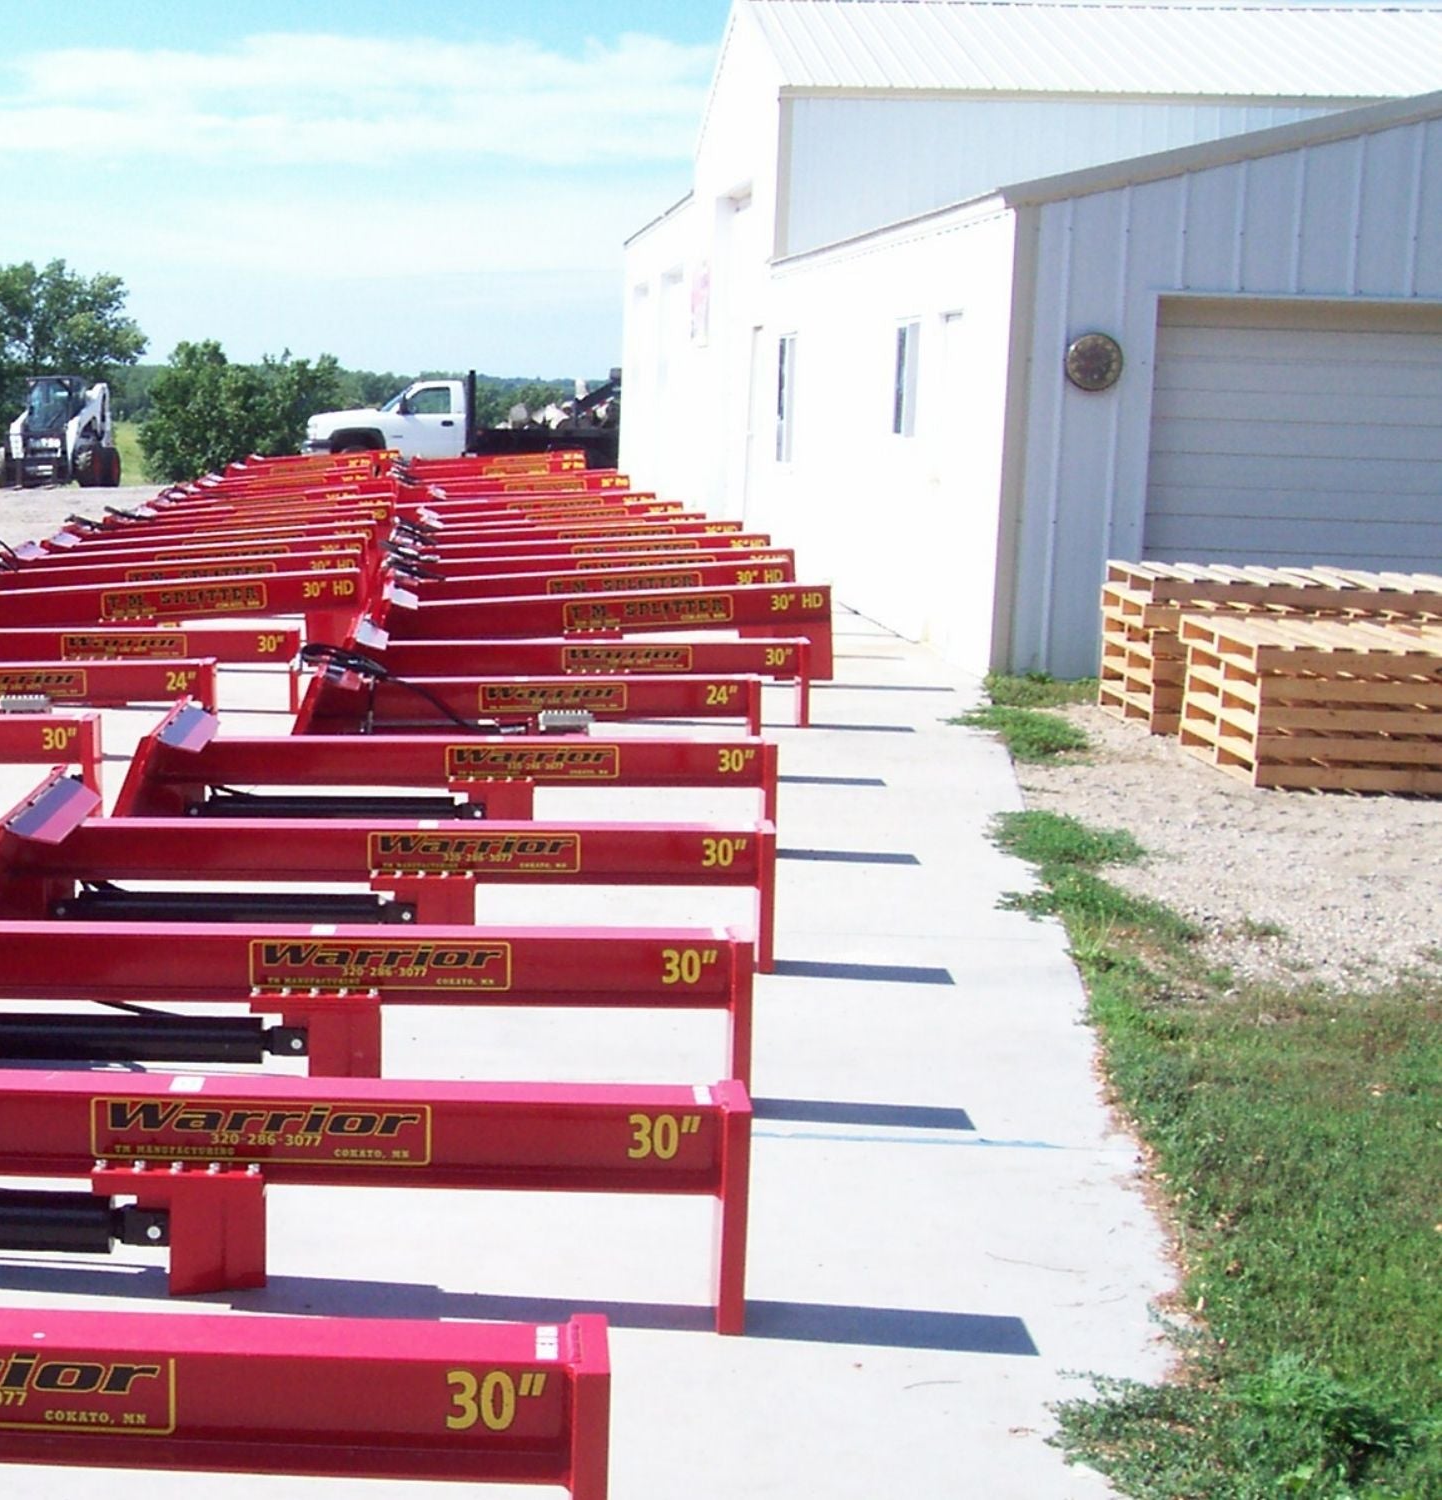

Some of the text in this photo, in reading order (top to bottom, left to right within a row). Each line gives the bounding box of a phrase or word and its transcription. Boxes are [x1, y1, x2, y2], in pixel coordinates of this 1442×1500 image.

[764, 569, 783, 583] HD
[303, 581, 354, 597] 30" HD
[771, 593, 823, 610] 30" HD
[257, 635, 284, 652] 30"
[765, 648, 793, 666] 30"
[166, 671, 196, 691] 24"
[707, 685, 738, 704] 24"
[42, 728, 77, 750] 30"
[453, 747, 613, 764] Warrior
[718, 750, 754, 772] 30"
[377, 835, 574, 855] Warrior
[701, 839, 746, 865] 30"
[263, 943, 504, 968] Warrior
[342, 966, 428, 977] 320-286-3077
[662, 950, 717, 983] 30"
[106, 1100, 421, 1137] Warrior
[211, 1132, 321, 1146] 320-286-3077
[627, 1114, 701, 1159] 30"
[114, 1145, 409, 1159] TM MANUFACTURING COKATO, MN
[446, 1370, 546, 1430] 30"
[45, 1410, 115, 1425] COKATO,
[123, 1413, 146, 1424] MN
